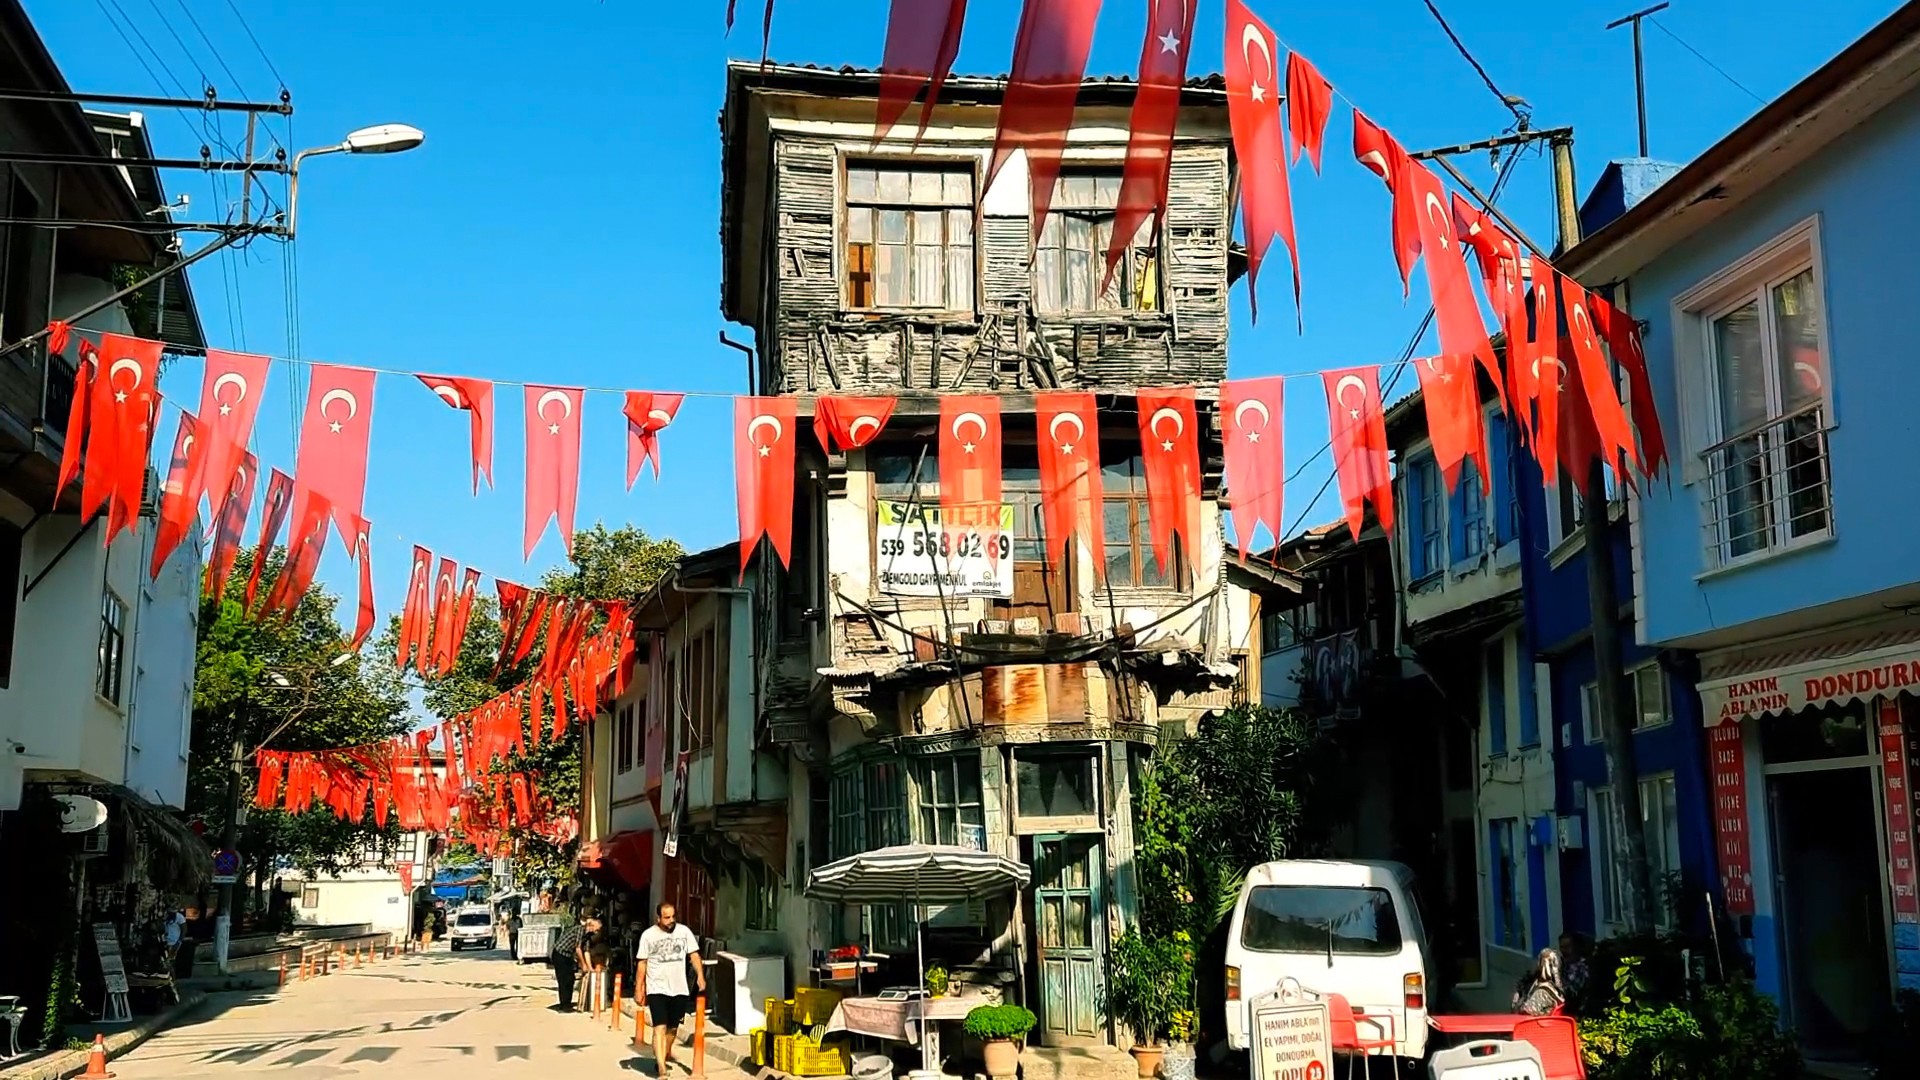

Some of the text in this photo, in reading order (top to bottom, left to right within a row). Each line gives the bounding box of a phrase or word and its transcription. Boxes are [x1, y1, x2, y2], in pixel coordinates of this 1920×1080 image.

[881, 531, 1010, 559] 539 568 02 69
[1728, 677, 1778, 698] HANIM
[1720, 693, 1789, 717] ABLA'NIN
[1718, 749, 1735, 764] SADE
[1717, 772, 1739, 787] KAKAO
[1720, 793, 1740, 812] VİŞNE
[1721, 816, 1742, 833] LİMON
[1728, 864, 1742, 879] MUZ
[1727, 887, 1747, 904] ÇİLEK
[1265, 1019, 1289, 1031] HANIM
[1264, 1037, 1273, 1048] EL
[1302, 1031, 1323, 1043] DOĞAL
[1276, 1049, 1316, 1062] DONDURMA
